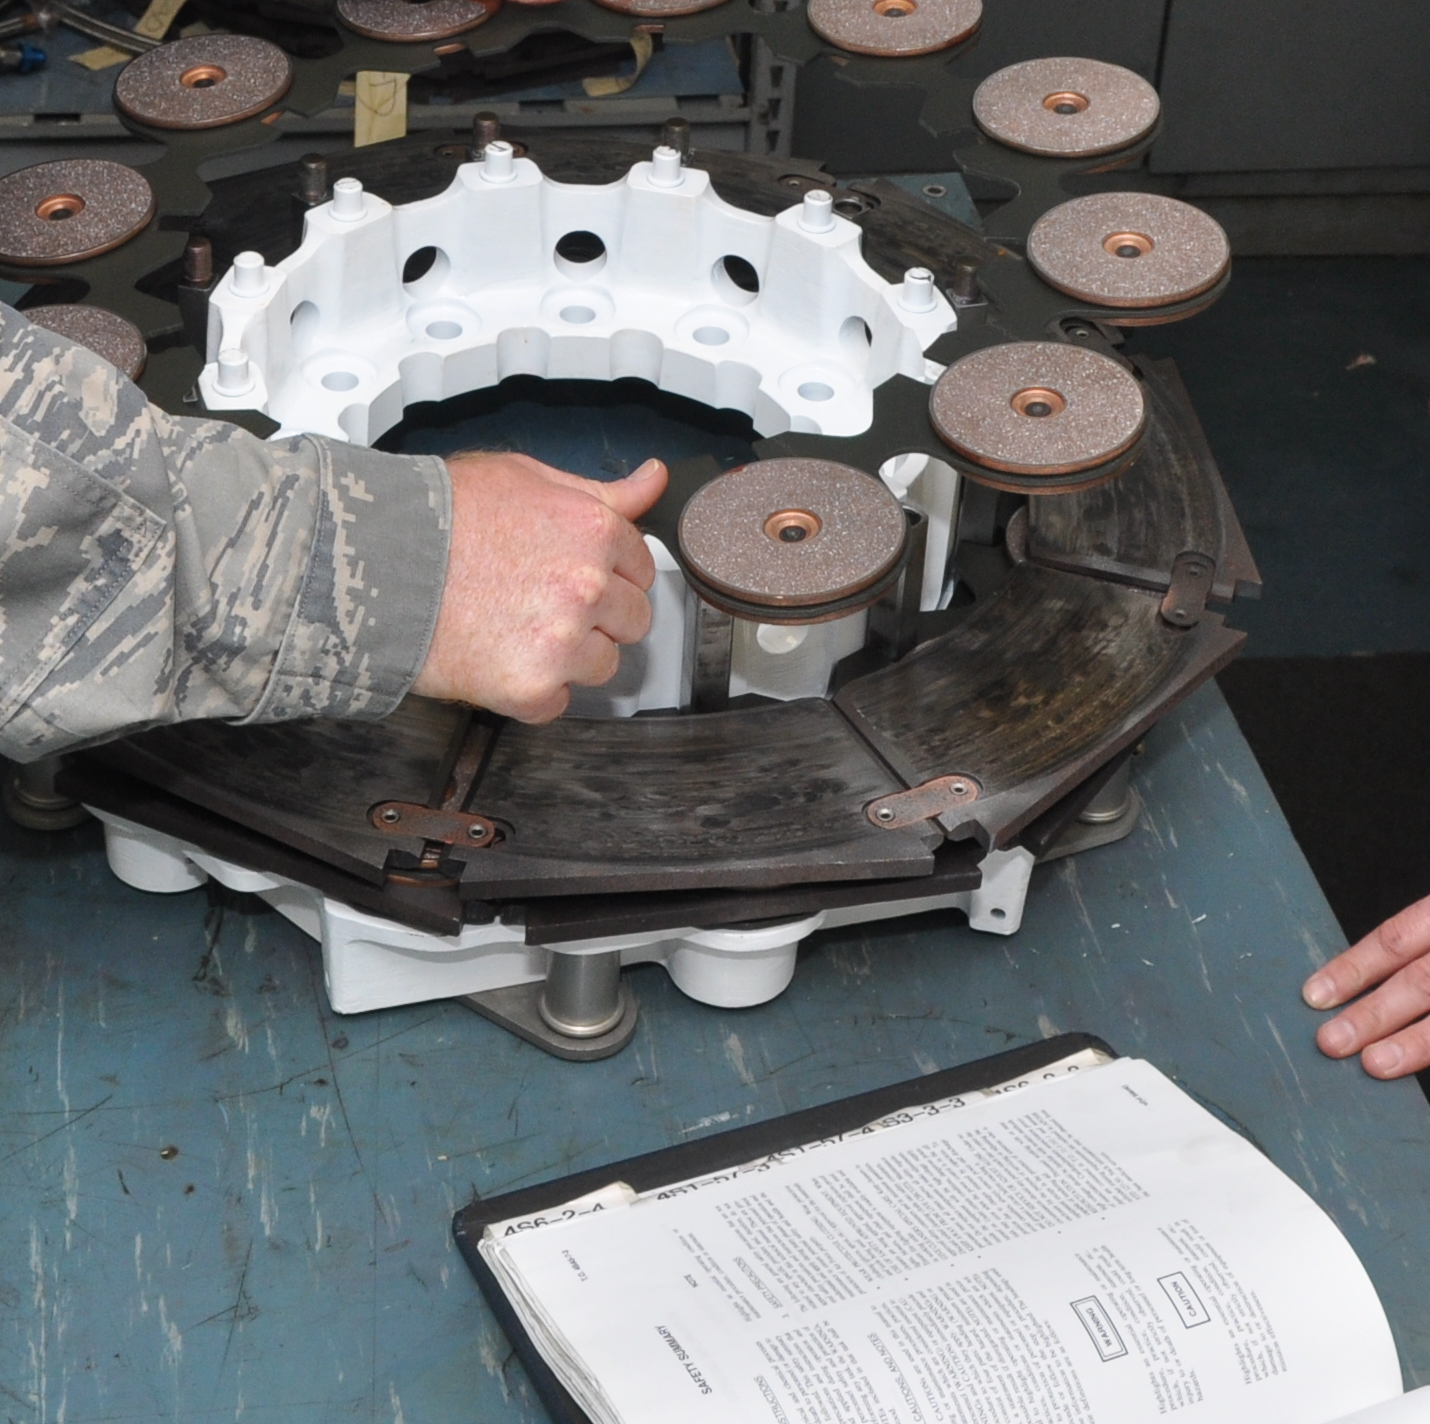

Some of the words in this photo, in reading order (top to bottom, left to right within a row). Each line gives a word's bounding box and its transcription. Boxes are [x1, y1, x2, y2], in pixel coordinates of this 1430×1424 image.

[881, 1096, 966, 1128] S3-3-3
[1171, 1280, 1198, 1318] CAUTION
[653, 1323, 690, 1361] SUMMARY
[866, 1331, 889, 1357] NOTES
[1085, 1306, 1113, 1348] WARNING
[681, 1361, 714, 1395] SAFETY
[882, 1355, 898, 1374] AND
